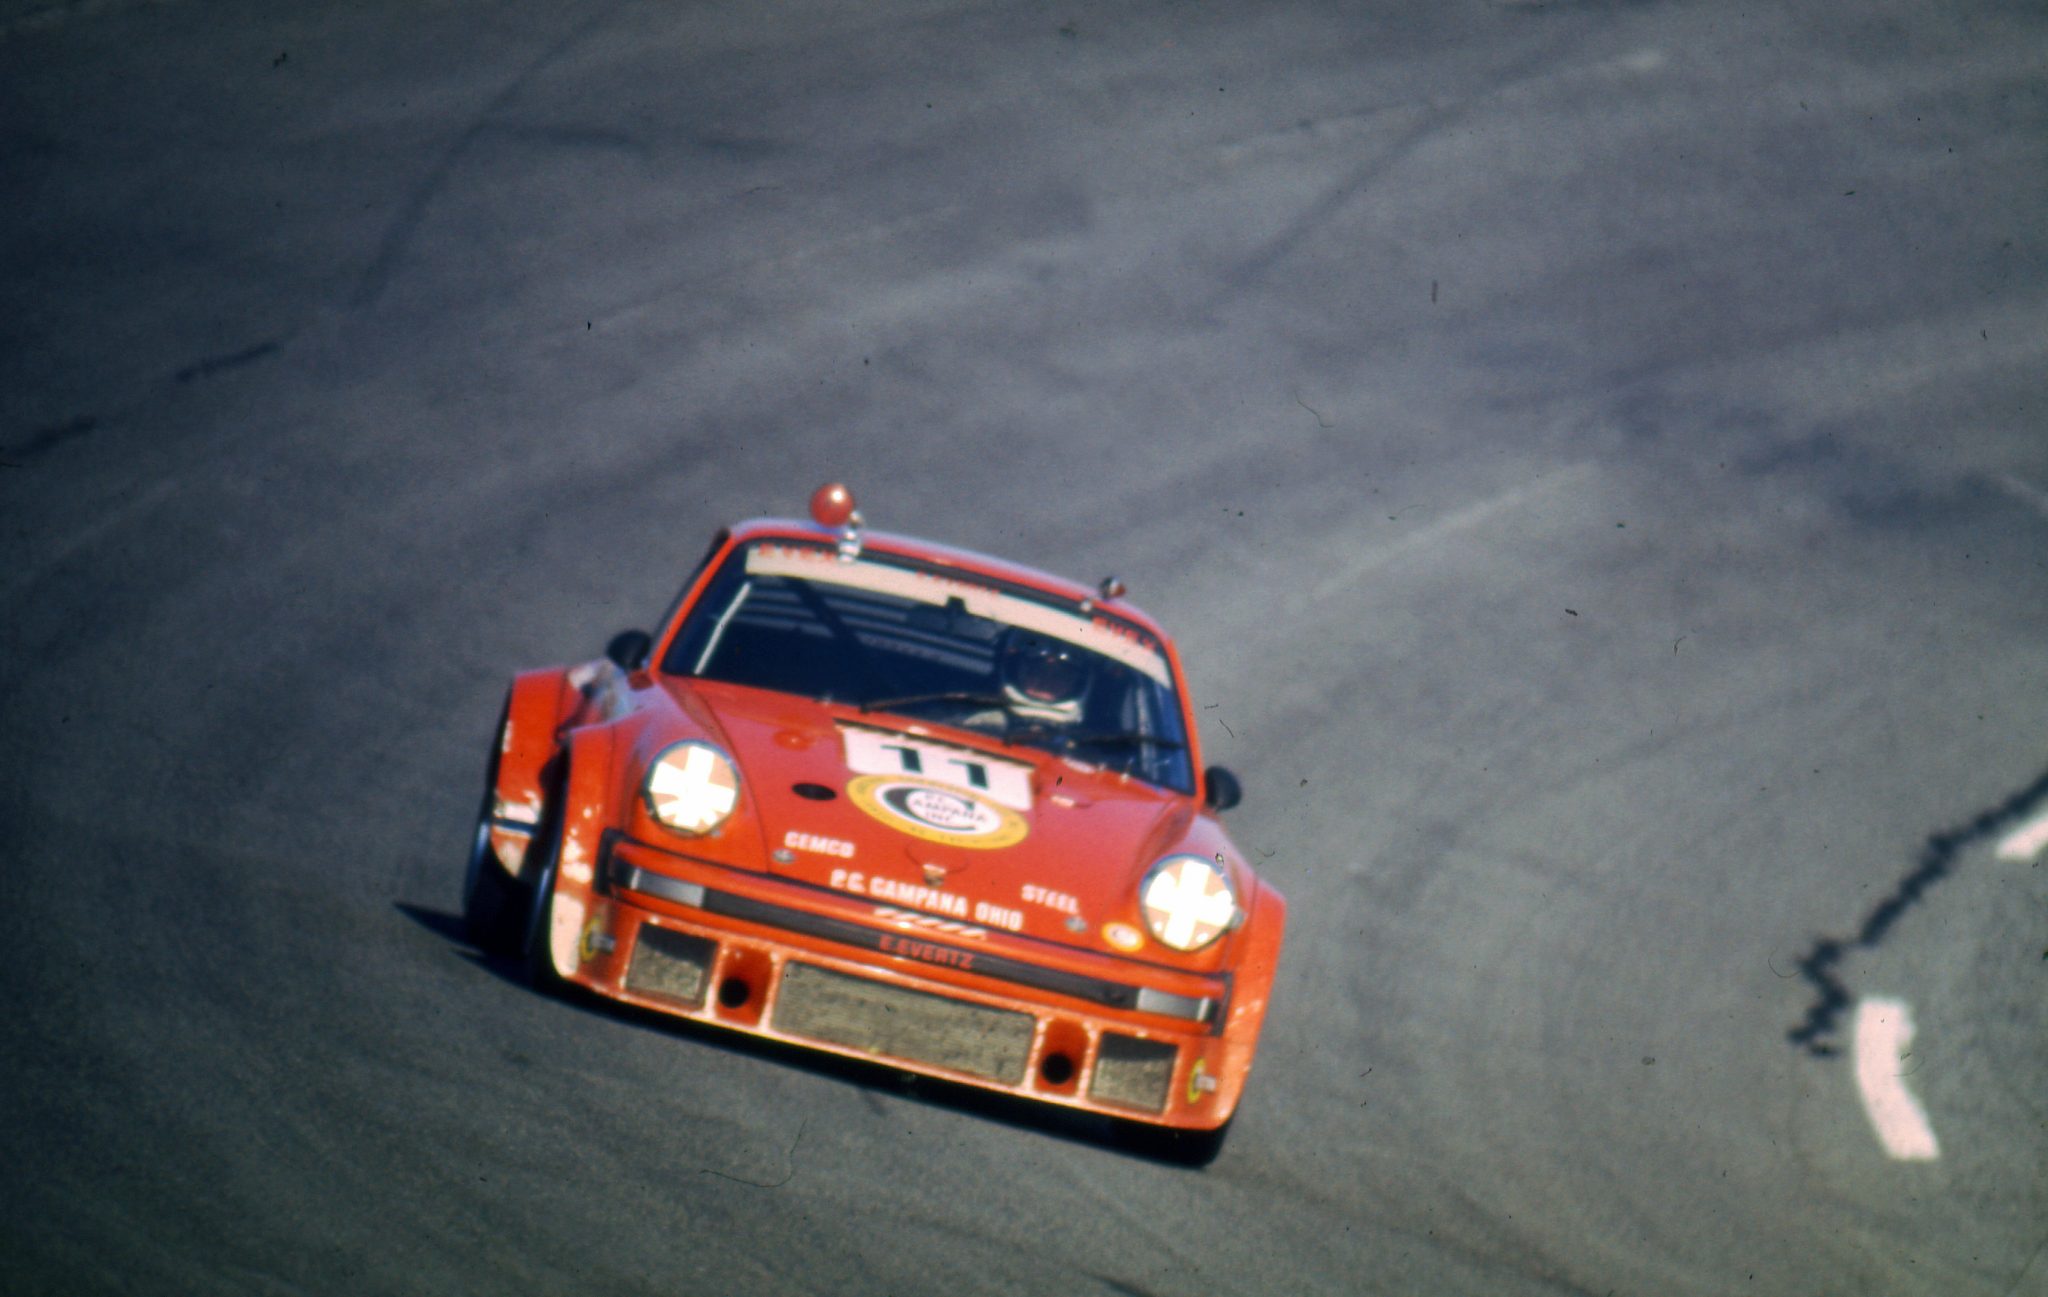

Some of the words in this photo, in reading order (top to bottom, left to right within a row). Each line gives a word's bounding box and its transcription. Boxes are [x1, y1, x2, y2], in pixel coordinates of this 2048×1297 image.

[879, 743, 991, 792] 11
[869, 875, 967, 917] CAMPANA
[974, 900, 1025, 932] OHIO
[1020, 883, 1081, 915] STEEL
[896, 937, 977, 970] EVERTZ
